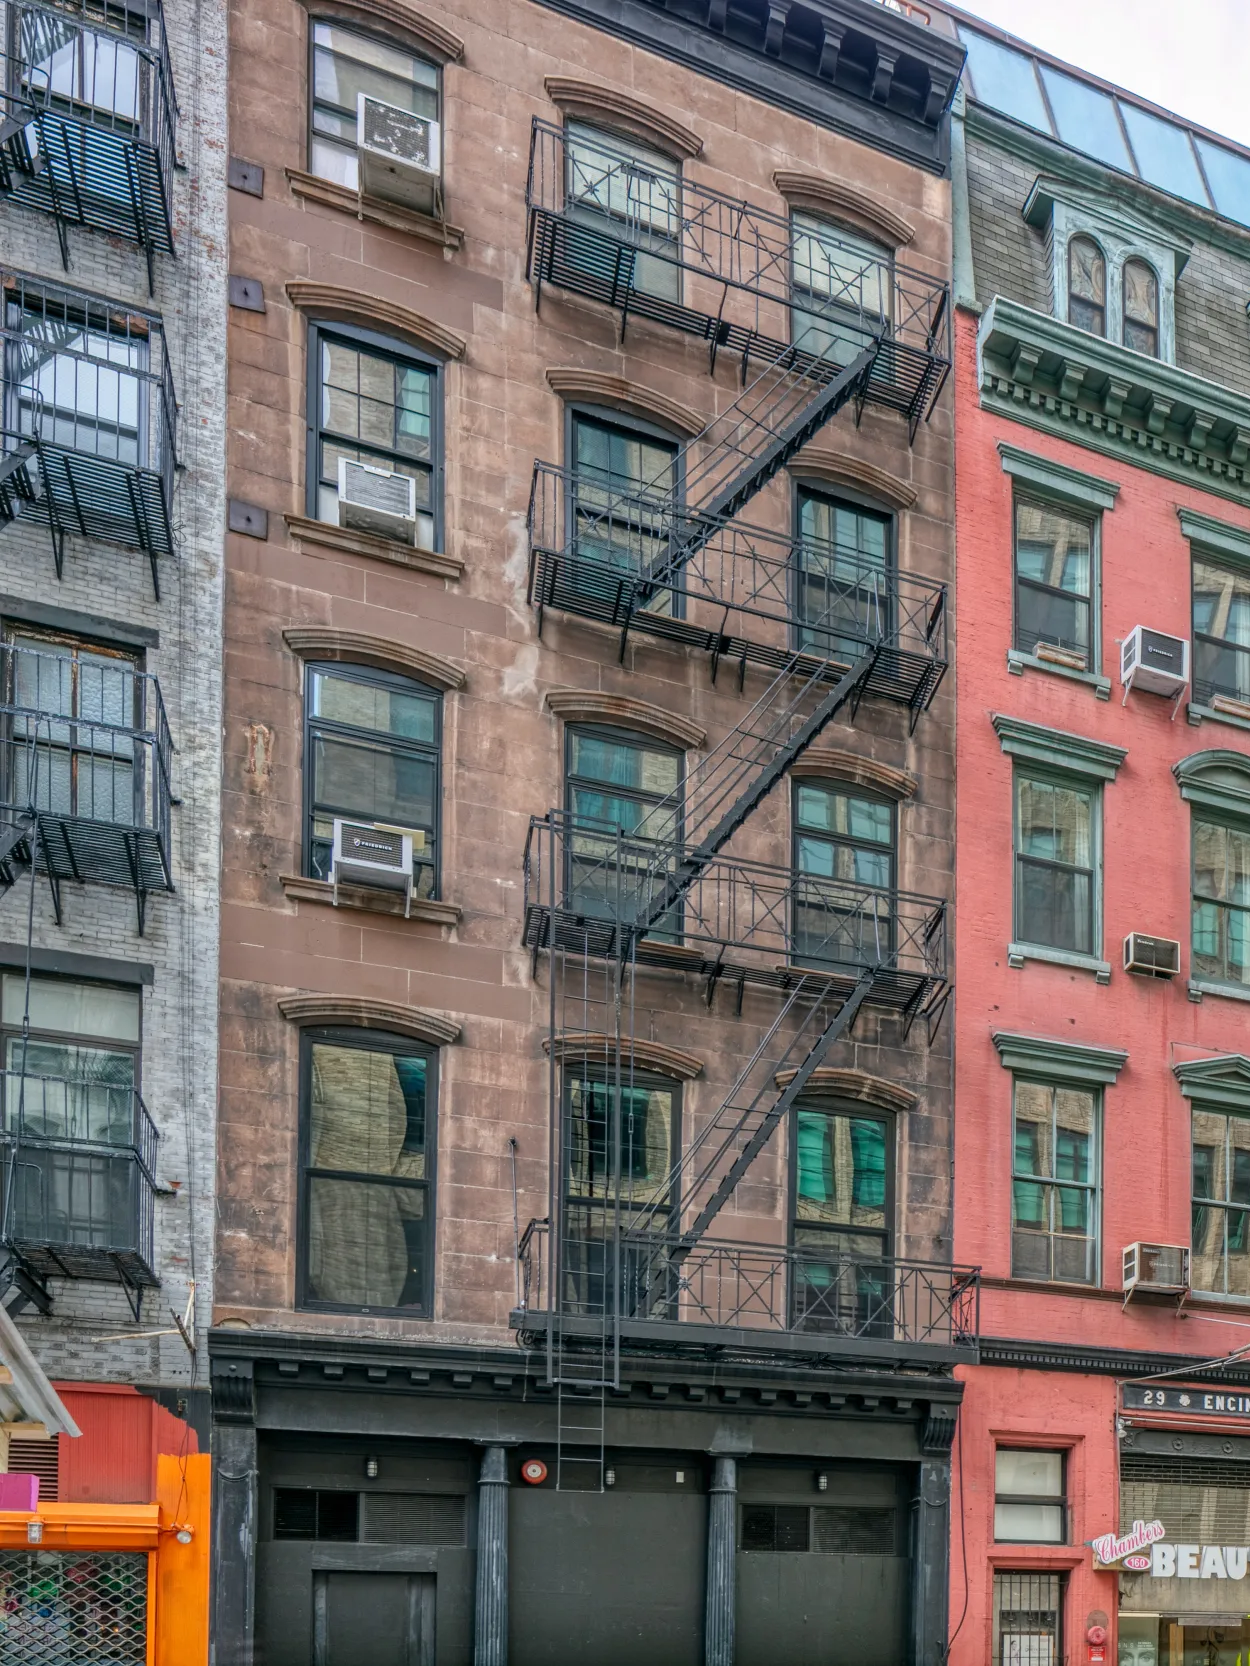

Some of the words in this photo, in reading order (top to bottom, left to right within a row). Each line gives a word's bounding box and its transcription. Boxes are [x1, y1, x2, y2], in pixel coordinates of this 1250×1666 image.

[1143, 1390, 1165, 1406] 29
[1095, 1521, 1164, 1563] Chambers
[1130, 1558, 1146, 1568] 160
